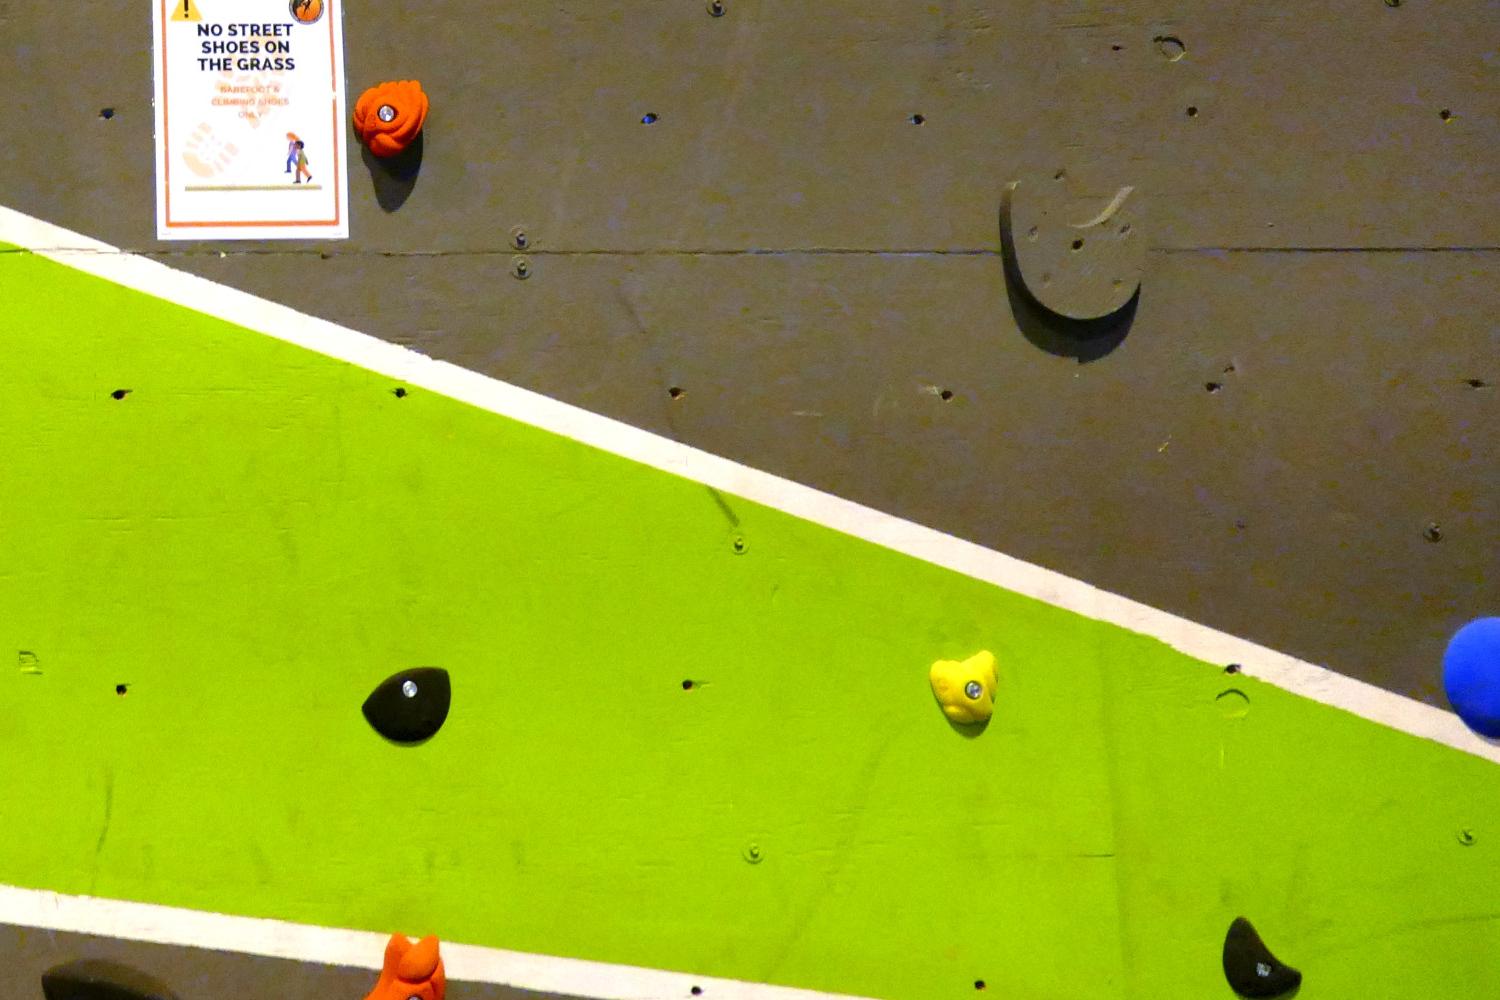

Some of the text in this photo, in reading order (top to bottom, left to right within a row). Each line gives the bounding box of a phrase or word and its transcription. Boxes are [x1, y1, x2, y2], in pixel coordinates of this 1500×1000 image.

[197, 23, 294, 37] NO STREET
[201, 40, 290, 54] SHOES ON
[197, 57, 296, 71] THE GRASS
[211, 97, 290, 106] CLIMBING SHOES
[238, 110, 263, 119] ONLY
